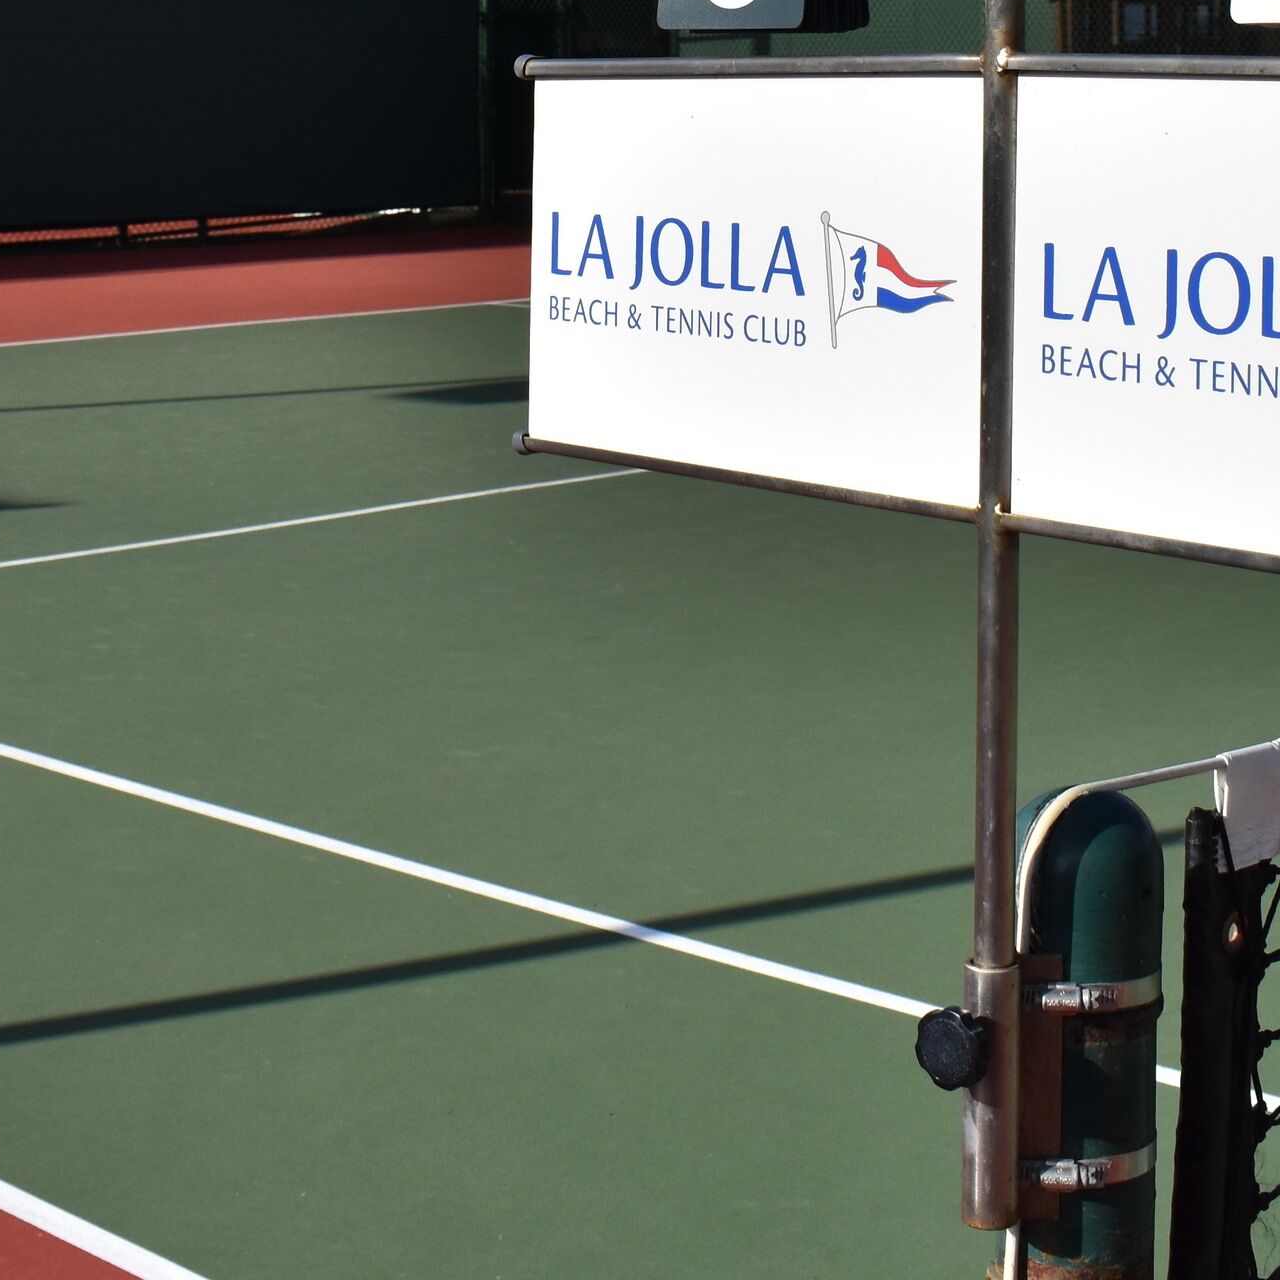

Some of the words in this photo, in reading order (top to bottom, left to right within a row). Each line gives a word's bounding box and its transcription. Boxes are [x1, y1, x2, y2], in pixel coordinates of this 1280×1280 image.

[550, 211, 614, 280] LA
[629, 215, 806, 297] JOLLA
[1042, 242, 1136, 327] LA
[549, 295, 618, 327] BEACH
[627, 303, 642, 330] &
[650, 305, 734, 340] TENNIS
[743, 314, 807, 347] CLUB
[1041, 344, 1141, 384] BEACH
[1154, 357, 1176, 388] &
